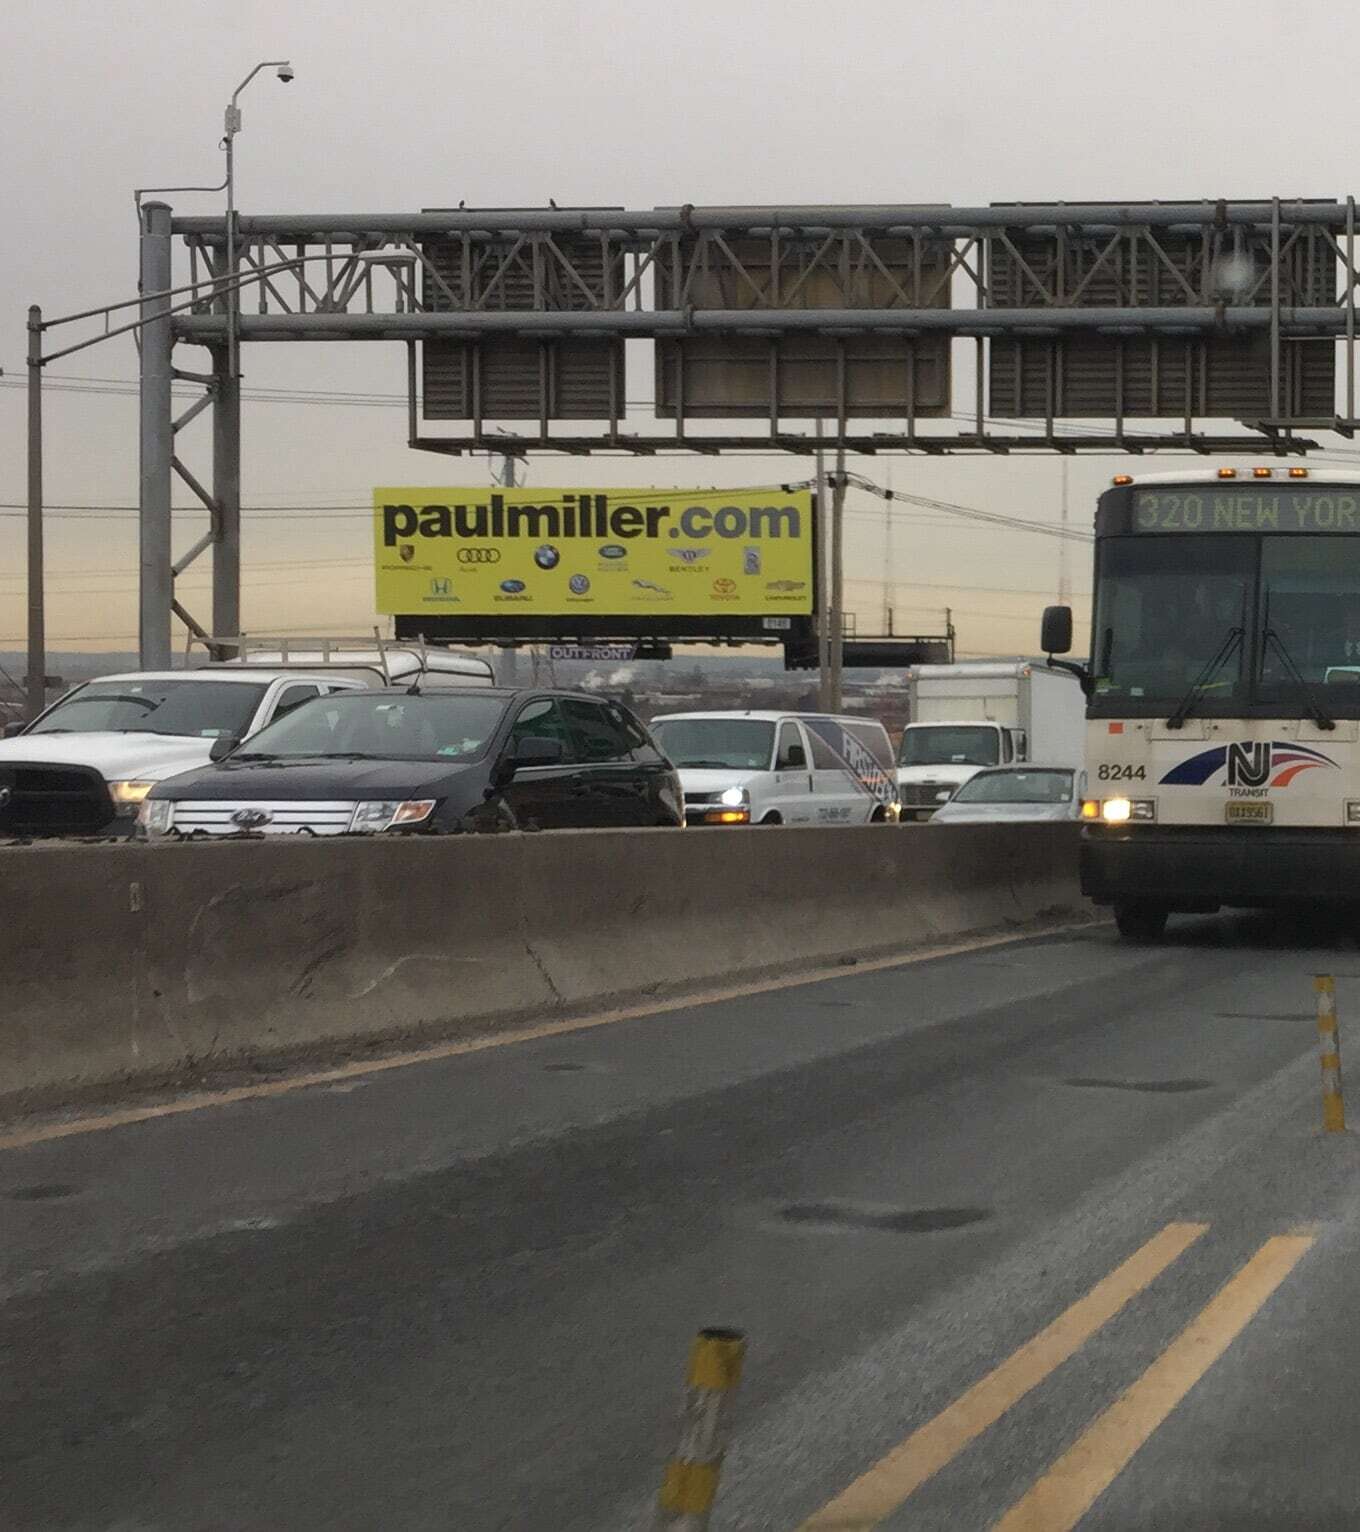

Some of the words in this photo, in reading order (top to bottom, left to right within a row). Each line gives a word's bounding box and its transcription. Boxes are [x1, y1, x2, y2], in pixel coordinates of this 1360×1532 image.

[383, 494, 801, 547] paulmiller.com
[1138, 496, 1201, 529] 320
[1213, 497, 1279, 529] NEW
[552, 646, 632, 660] OUTFRONT
[1098, 764, 1146, 781] 8244
[1229, 788, 1269, 797] TRANSIT
